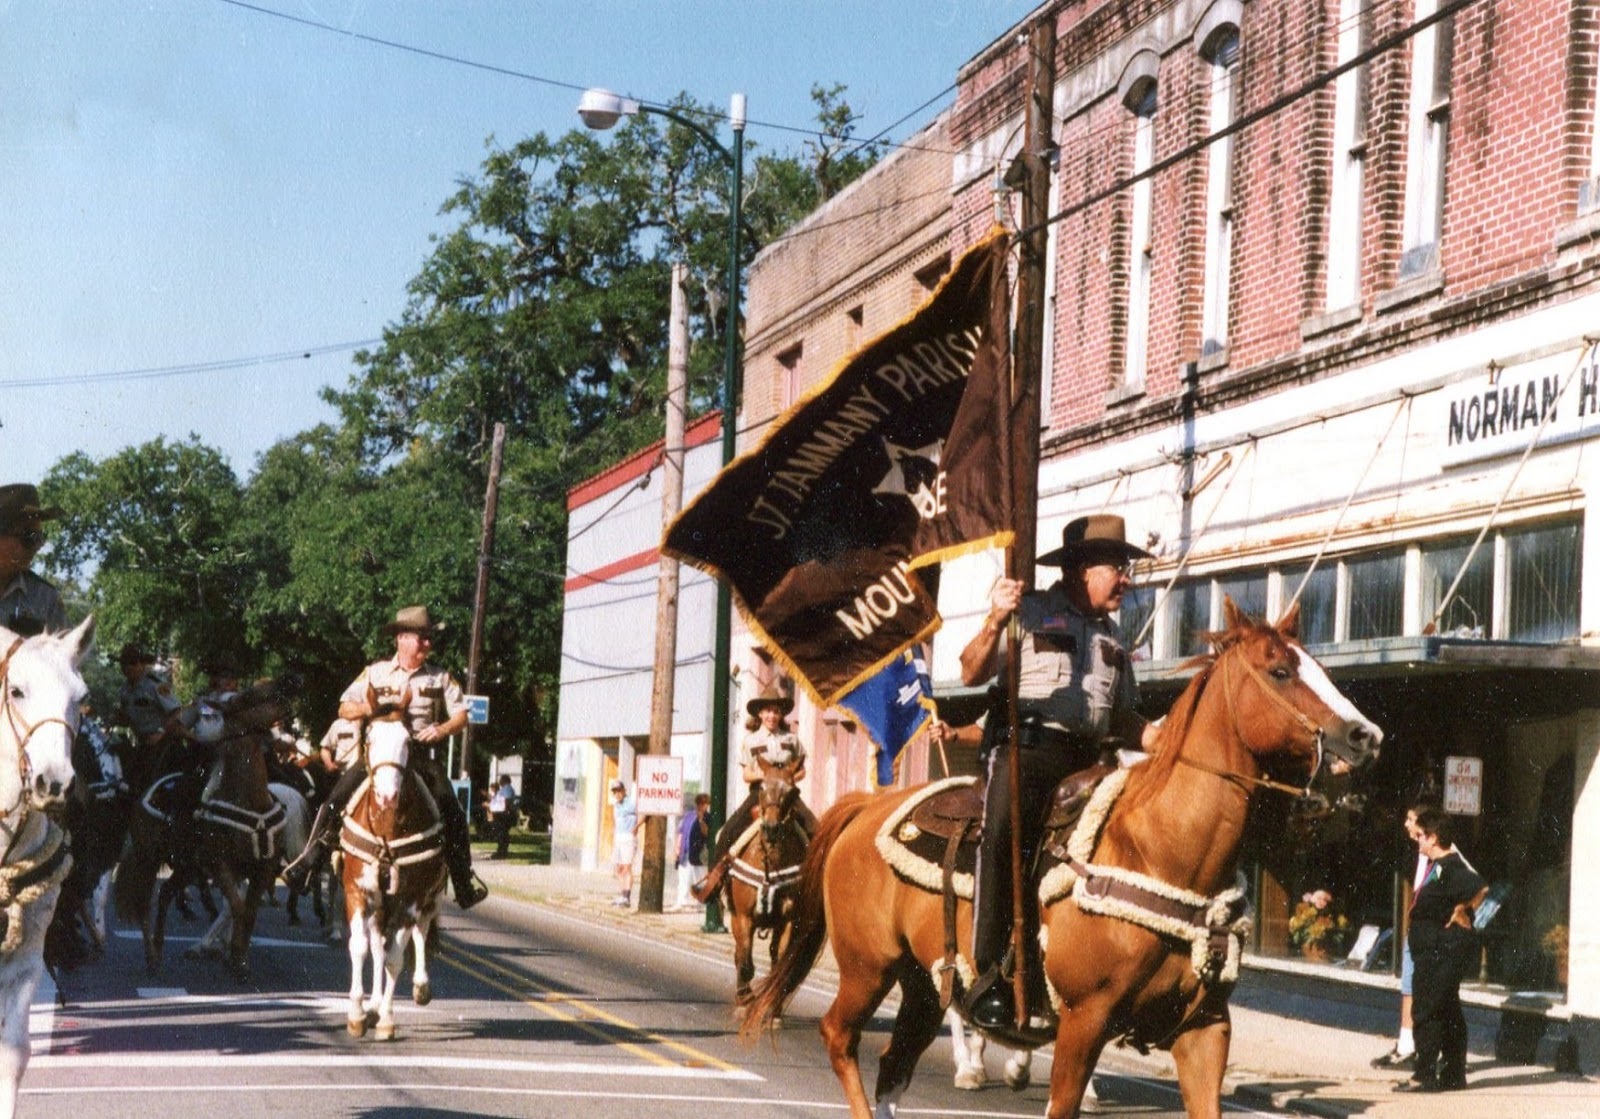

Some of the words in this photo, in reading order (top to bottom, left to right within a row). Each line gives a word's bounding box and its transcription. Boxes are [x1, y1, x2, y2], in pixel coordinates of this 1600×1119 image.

[1448, 373, 1559, 446] NORMAN
[1578, 363, 1600, 417] H
[768, 384, 890, 500] TAMMANY
[638, 788, 681, 800] PARKING
[652, 772, 669, 783] NO
